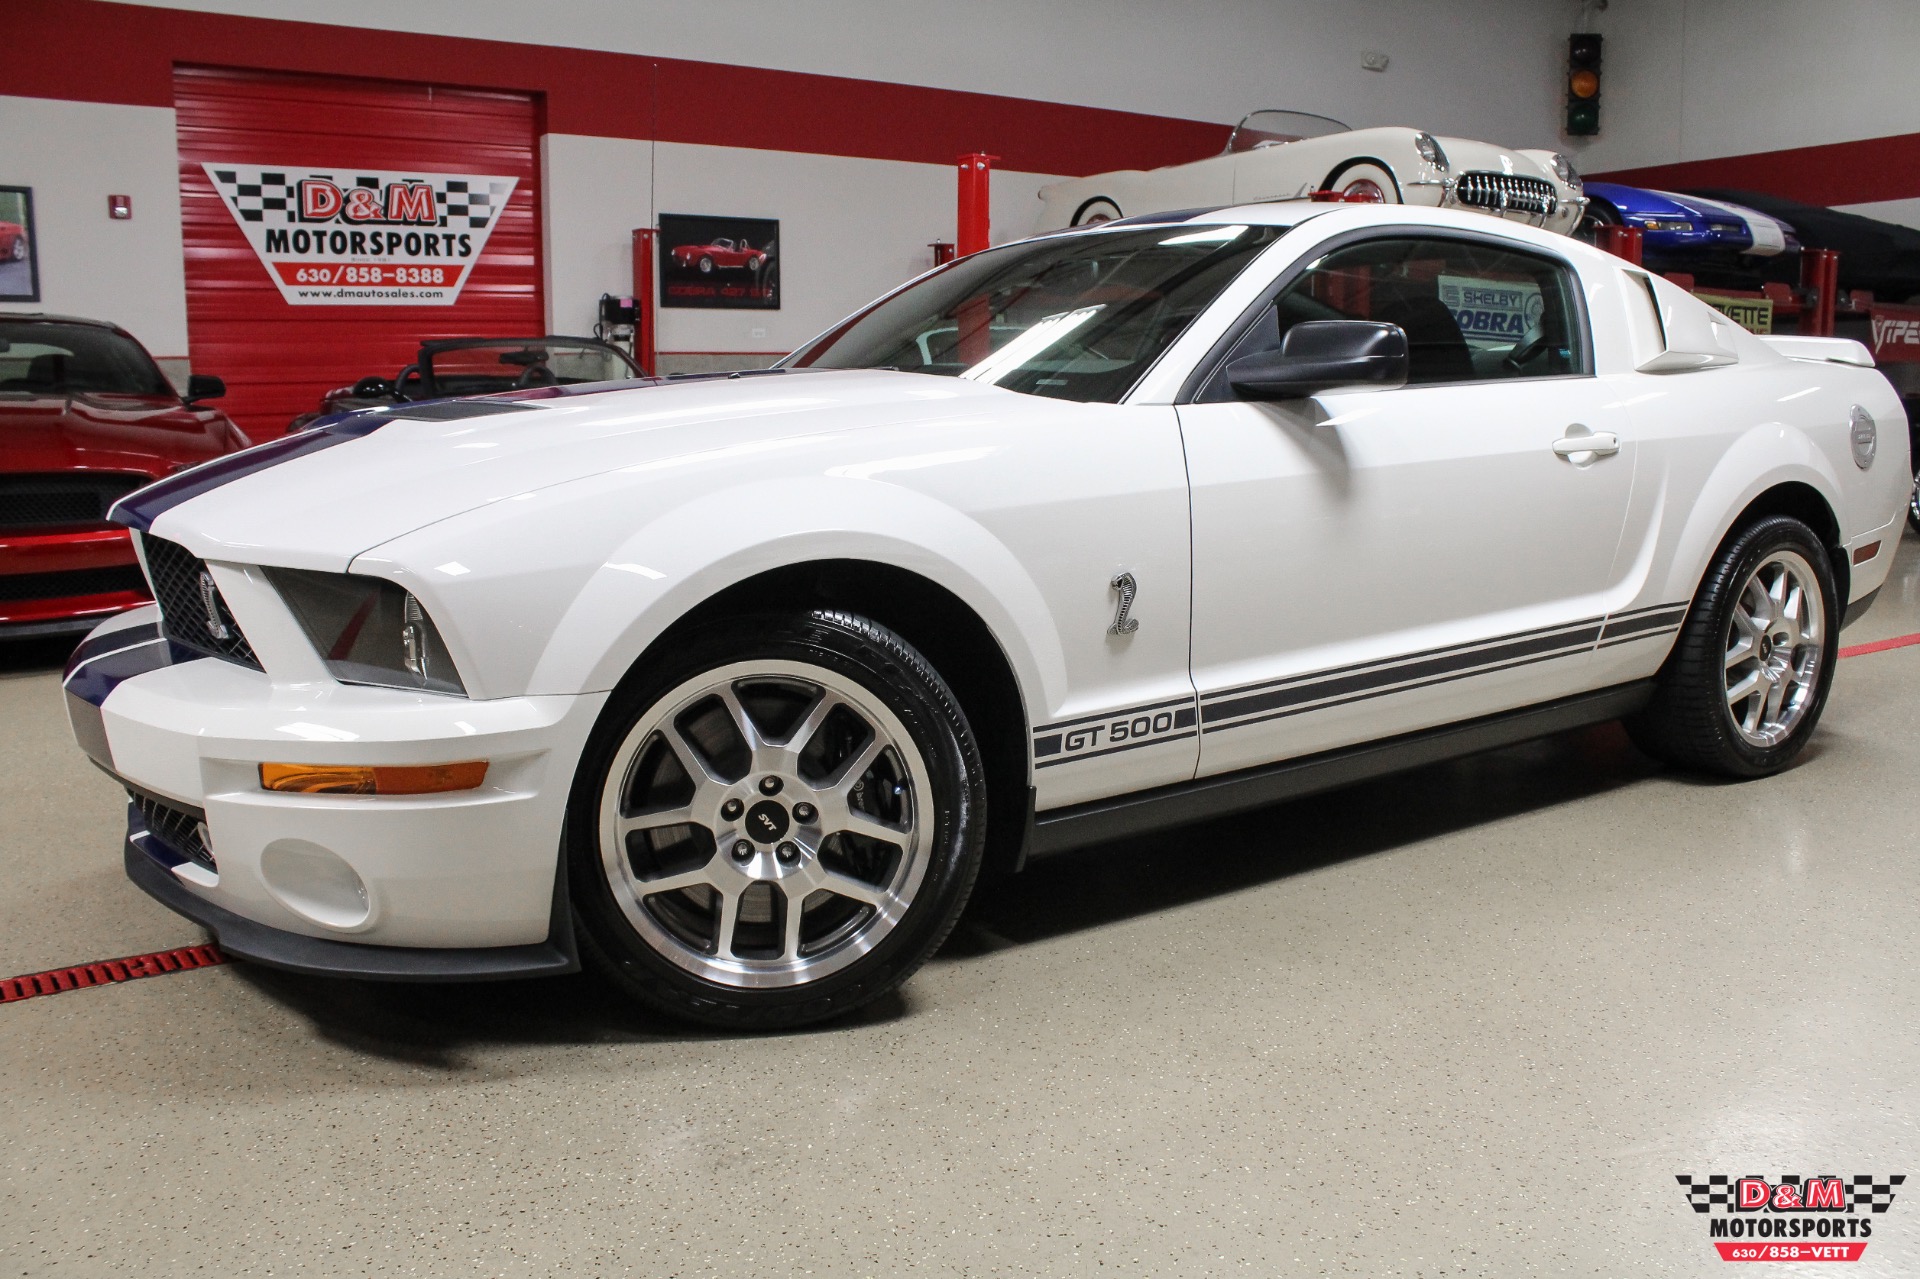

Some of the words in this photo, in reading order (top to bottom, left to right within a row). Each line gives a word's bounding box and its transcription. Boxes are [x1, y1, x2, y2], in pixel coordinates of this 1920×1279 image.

[298, 179, 437, 226] D&M
[266, 228, 472, 257] MOTORSPORTS
[296, 265, 444, 284] 630/858-8388
[298, 288, 444, 299] www.dmautosales.com
[1463, 291, 1518, 306] SHELBY
[1871, 319, 1920, 354] VIPE
[1065, 724, 1106, 752] GT
[1110, 712, 1173, 743] 500
[758, 813, 777, 831] SVT
